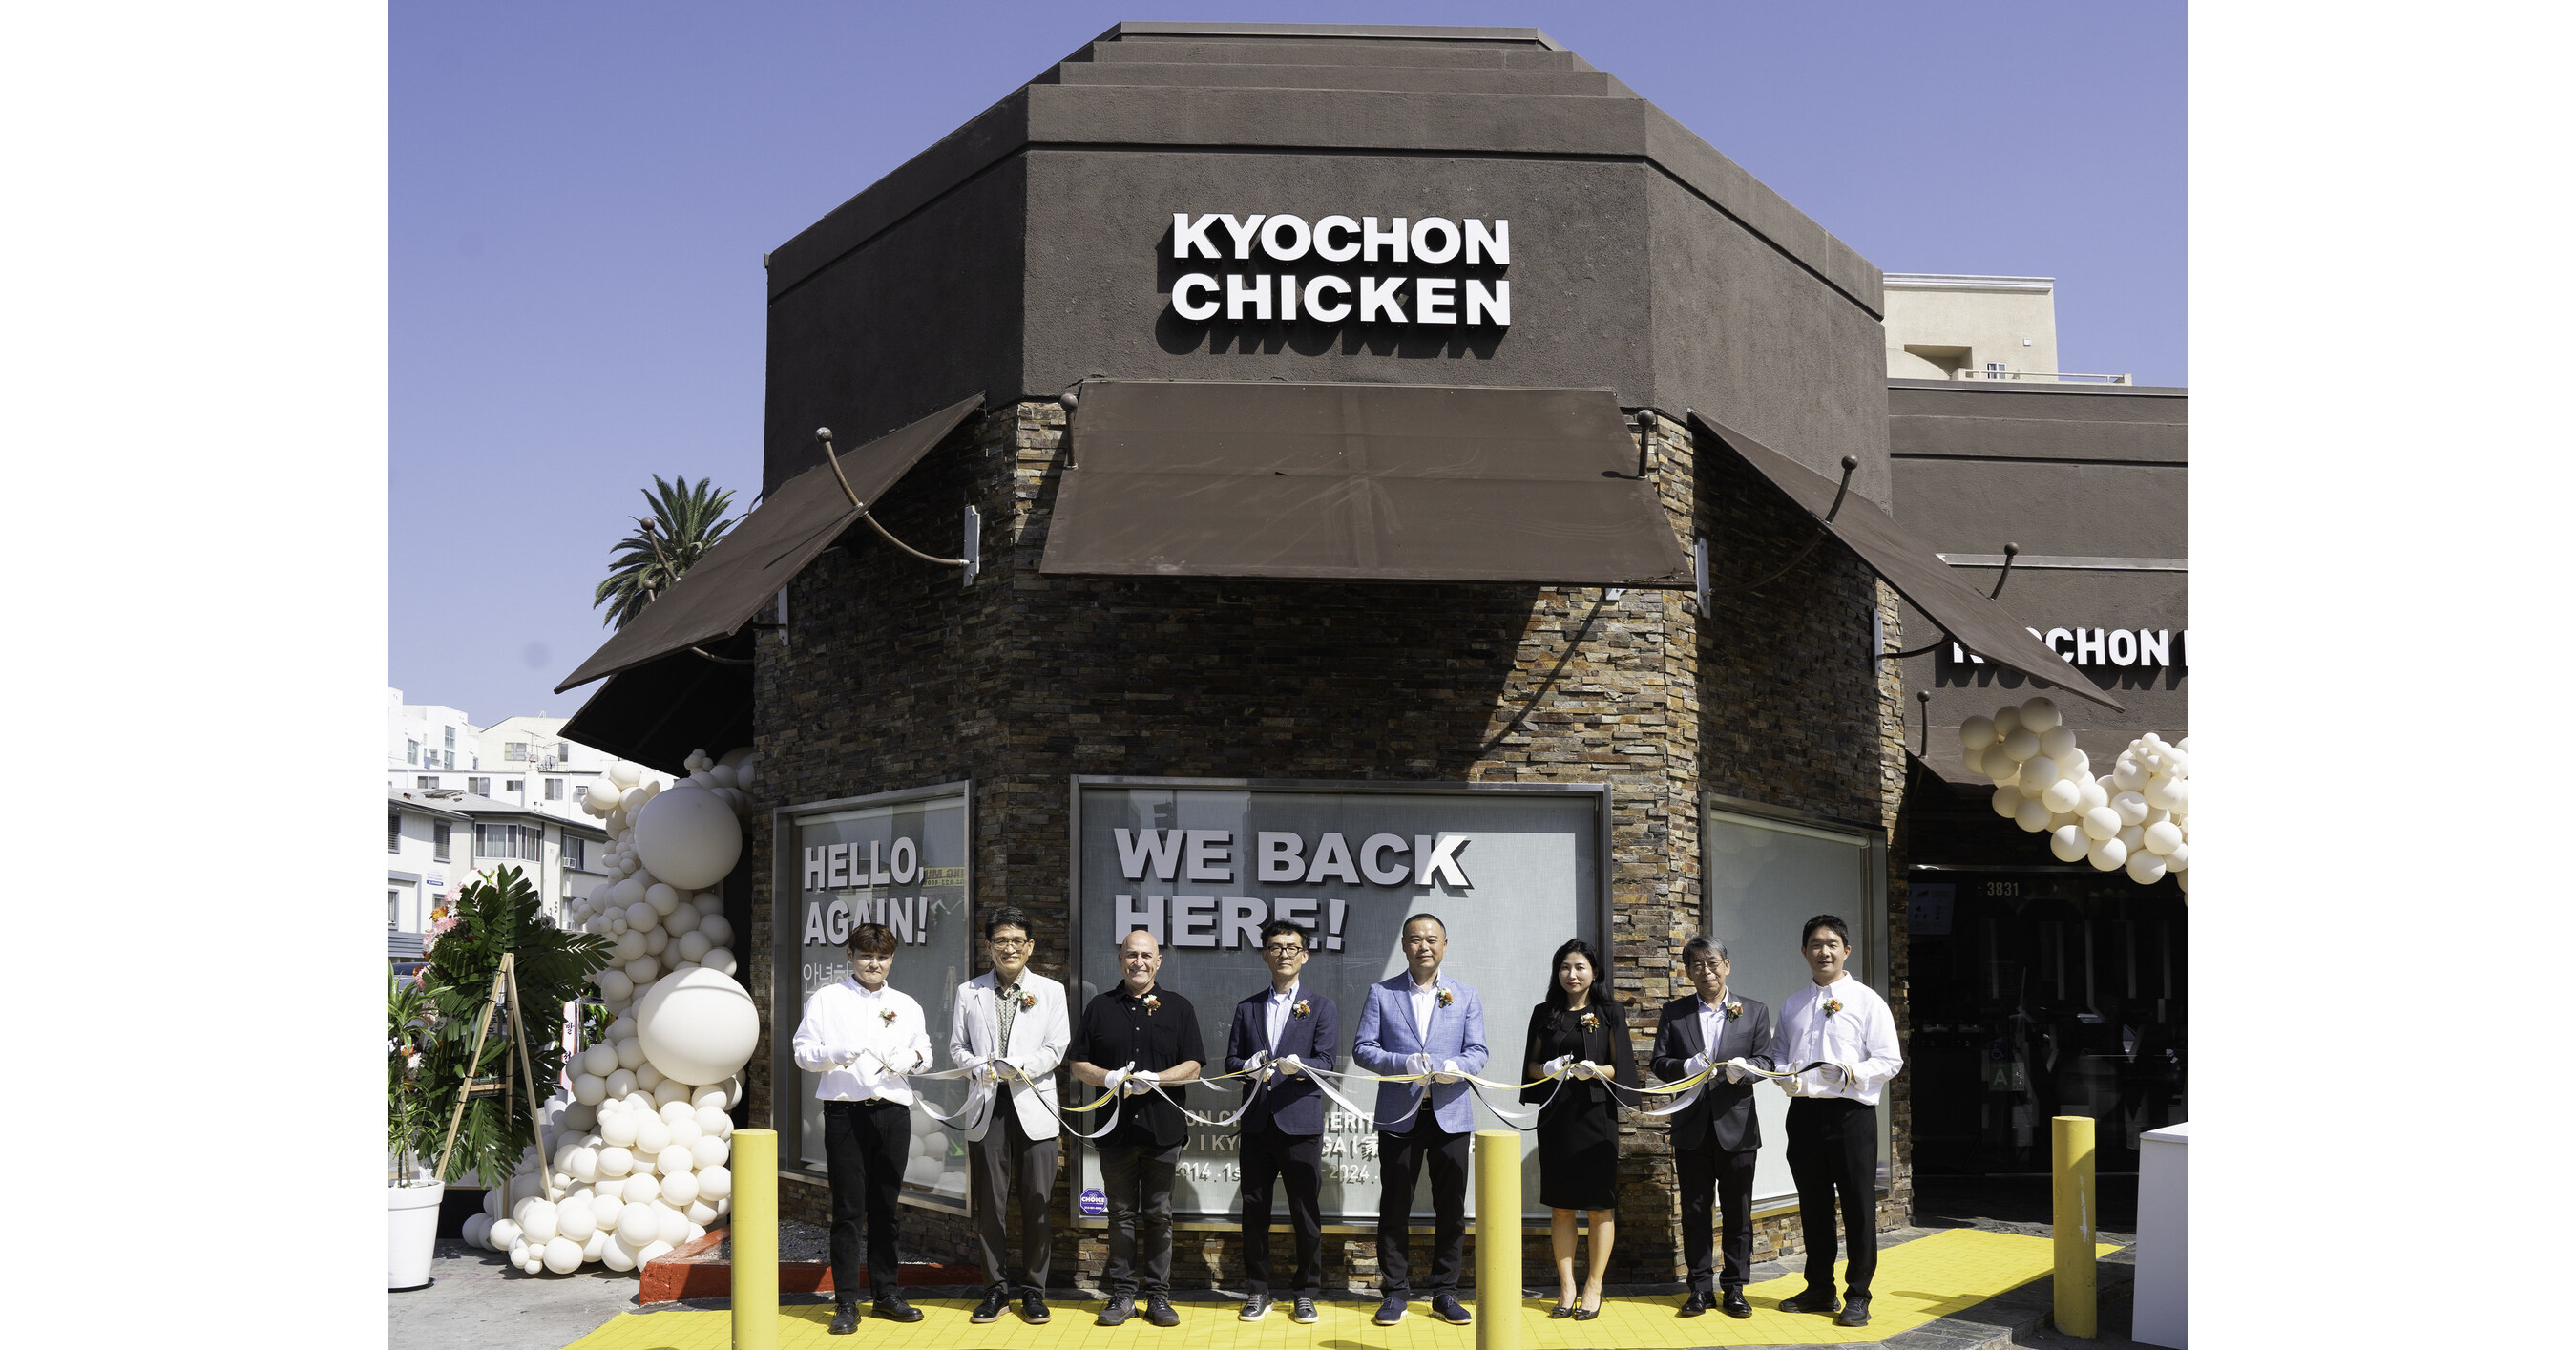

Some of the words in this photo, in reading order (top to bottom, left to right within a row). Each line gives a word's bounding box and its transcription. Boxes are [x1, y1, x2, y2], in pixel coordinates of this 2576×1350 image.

[1172, 213, 1510, 265] KYOCHON
[1171, 273, 1511, 326] CHICKEN
[1953, 626, 2170, 666] CHON
[805, 836, 924, 889] HELLO,
[1114, 828, 1230, 880] WE
[1258, 832, 1470, 886] BACK
[1987, 881, 2019, 896] 3831
[1115, 895, 1346, 951] HERE!
[1993, 1069, 2009, 1086] A
